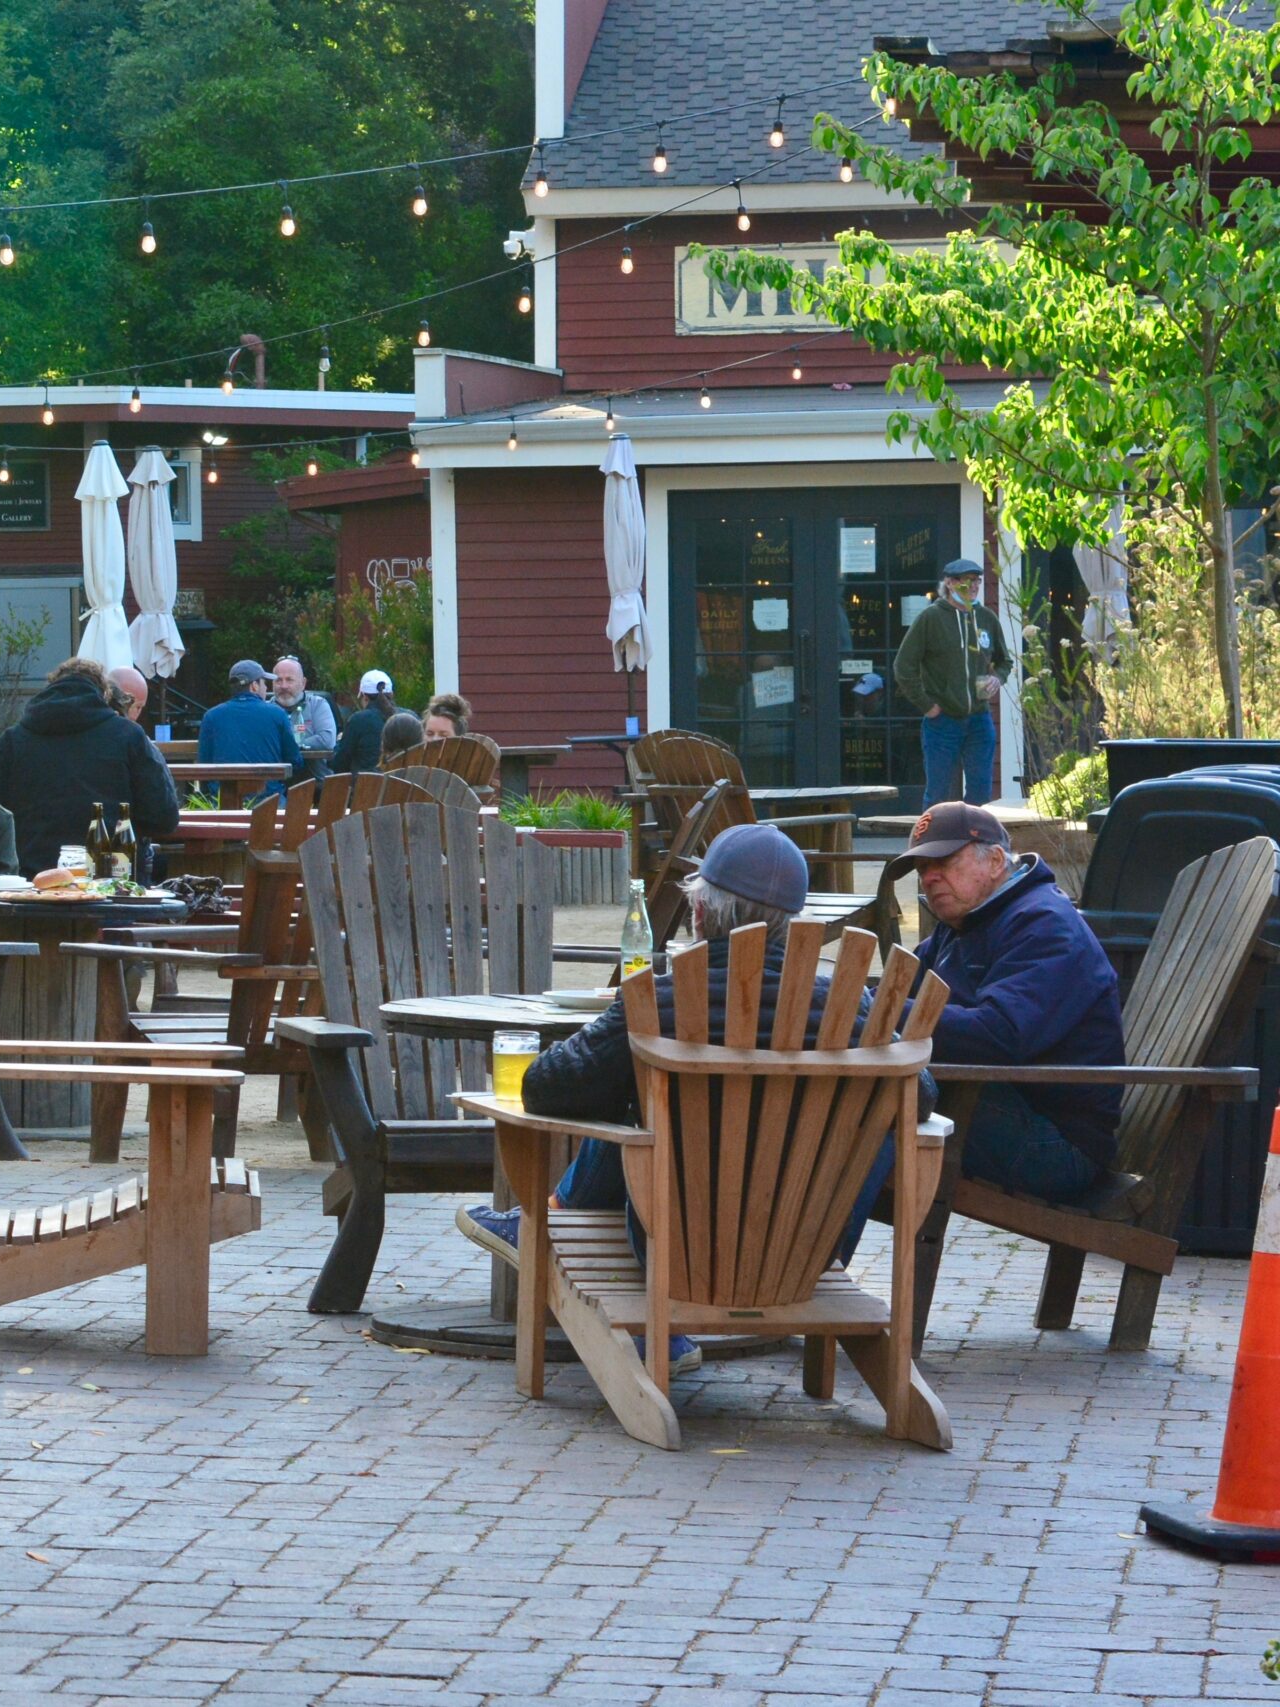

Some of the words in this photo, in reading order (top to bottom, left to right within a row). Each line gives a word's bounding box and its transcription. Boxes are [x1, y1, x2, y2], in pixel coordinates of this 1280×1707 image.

[1, 513, 33, 521] GALLERY
[701, 609, 738, 618] DAILY
[848, 628, 876, 637] TEA
